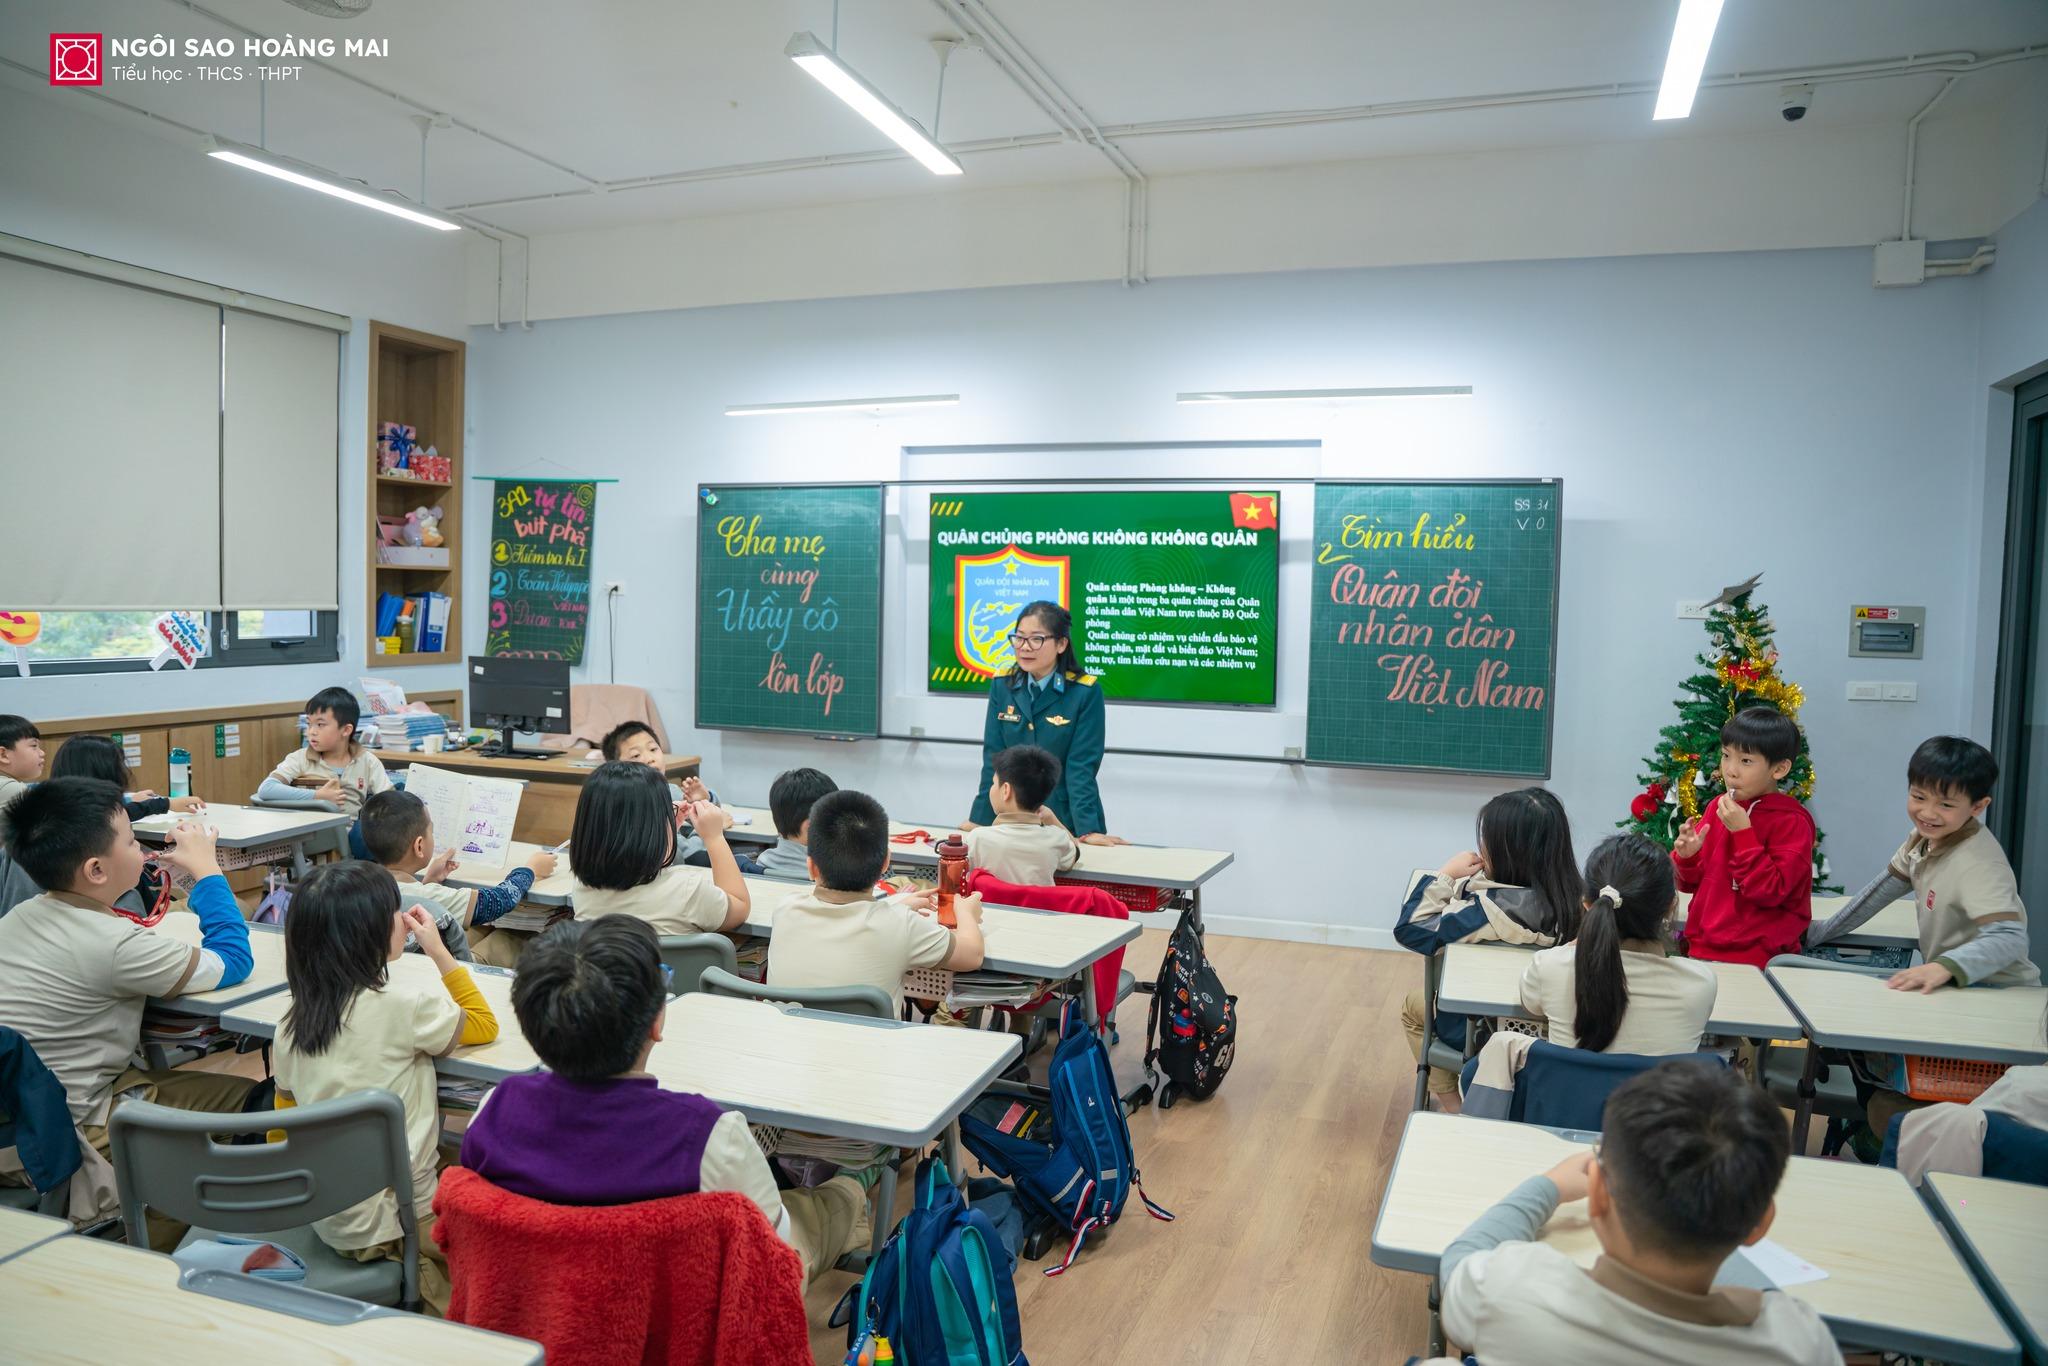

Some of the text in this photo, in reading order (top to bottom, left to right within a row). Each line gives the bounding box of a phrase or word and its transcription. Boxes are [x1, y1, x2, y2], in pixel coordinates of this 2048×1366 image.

[497, 485, 532, 518] 3A1
[549, 519, 590, 546] phá
[717, 515, 825, 561] Cha mẹ
[937, 528, 1258, 548] QUÂN CHỦNG PHÒNG KHÔNG KHÔNG QUÂN
[1341, 512, 1475, 550] Tìm hiểu
[491, 571, 507, 596] 2
[760, 562, 819, 603] cùng
[1086, 582, 1110, 593] Quân
[1140, 583, 1167, 594] Phòng
[1169, 583, 1196, 595] không
[1206, 584, 1236, 596] Không
[1331, 563, 1484, 620] Quân đội
[491, 601, 507, 628] 3
[803, 597, 839, 632] cô
[1085, 606, 1259, 620] đội nhân dân Việt Nam trực thuộc Bộ Quốc
[1086, 594, 1107, 605] quân
[1109, 595, 1117, 604] là
[1119, 595, 1135, 605] một
[1136, 596, 1158, 606] trong
[1159, 596, 1170, 604] ba
[1171, 596, 1191, 607] quân
[1220, 597, 1235, 606] của
[1237, 597, 1260, 608] Quân
[1085, 618, 1110, 629] phòng
[1338, 609, 1433, 645] nhân
[1085, 642, 1110, 653] không
[1152, 642, 1165, 653] đất
[1167, 645, 1177, 654] và
[1179, 643, 1197, 654] biển
[1198, 645, 1214, 655] đảo
[1216, 646, 1233, 657] Việt
[1235, 647, 1258, 657] Nam;
[1088, 631, 1109, 641] Quân
[1137, 632, 1147, 641] có
[1149, 632, 1174, 643] nhiệm
[1176, 635, 1187, 643] vụ
[1188, 631, 1211, 643] chiến
[1213, 632, 1228, 643] đấu
[1230, 634, 1245, 643] bảo
[1247, 634, 1258, 645] vệ
[1085, 654, 1100, 663] cứu
[1117, 655, 1131, 664] tìm
[1133, 654, 1153, 665] kiếm
[1155, 657, 1170, 666] cứu
[1172, 658, 1187, 668] nạn
[1189, 658, 1199, 667] và
[1201, 658, 1215, 667] các
[1217, 659, 1243, 669] nhiệm
[1245, 661, 1256, 670] vụ
[759, 651, 844, 716] lên lớp
[1377, 654, 1544, 712] Việt Nam
